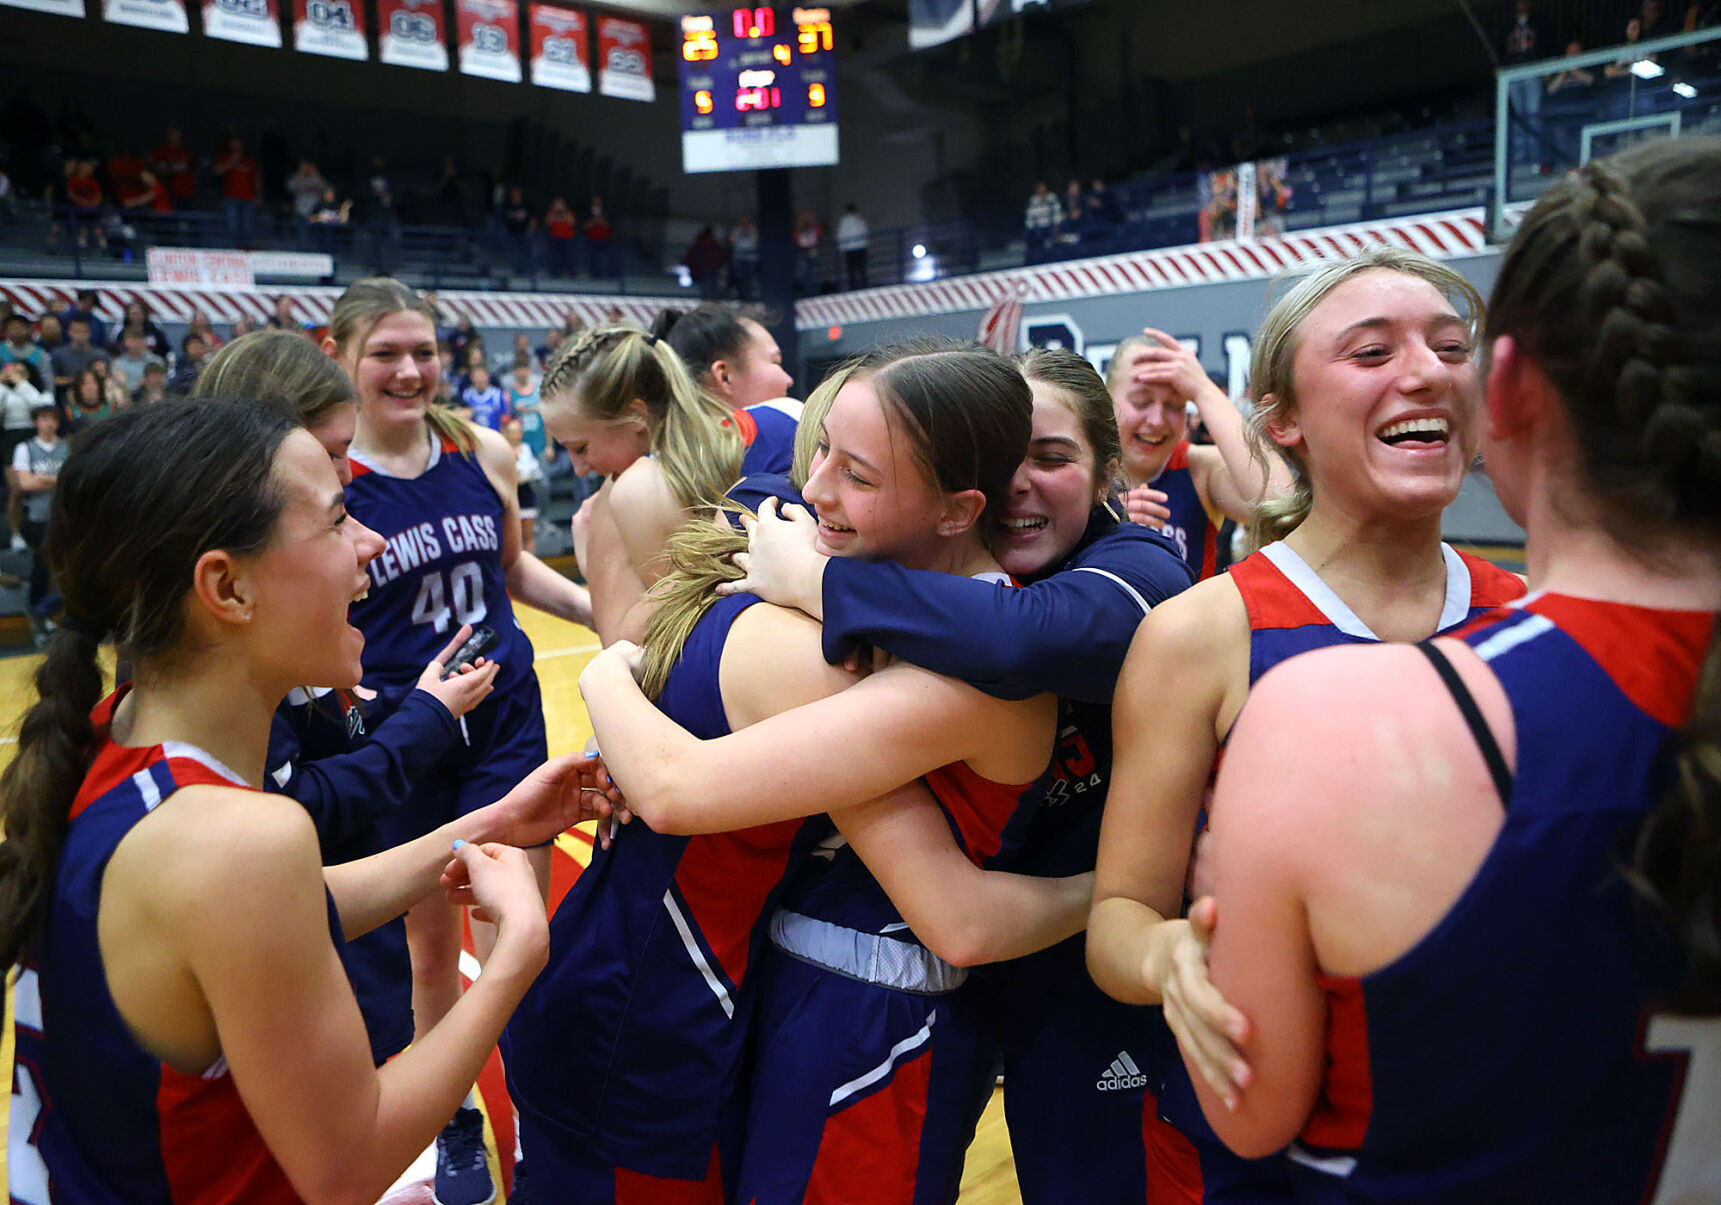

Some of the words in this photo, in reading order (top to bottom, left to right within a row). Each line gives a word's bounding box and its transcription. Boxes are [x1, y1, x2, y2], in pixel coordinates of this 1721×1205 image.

[798, 22, 833, 54] 37
[773, 44, 791, 66] 4
[370, 522, 442, 588] LEWIS
[442, 514, 498, 553] CASS
[411, 561, 487, 634] 40
[1074, 773, 1101, 794] 24
[1096, 1074, 1147, 1091] adidas
